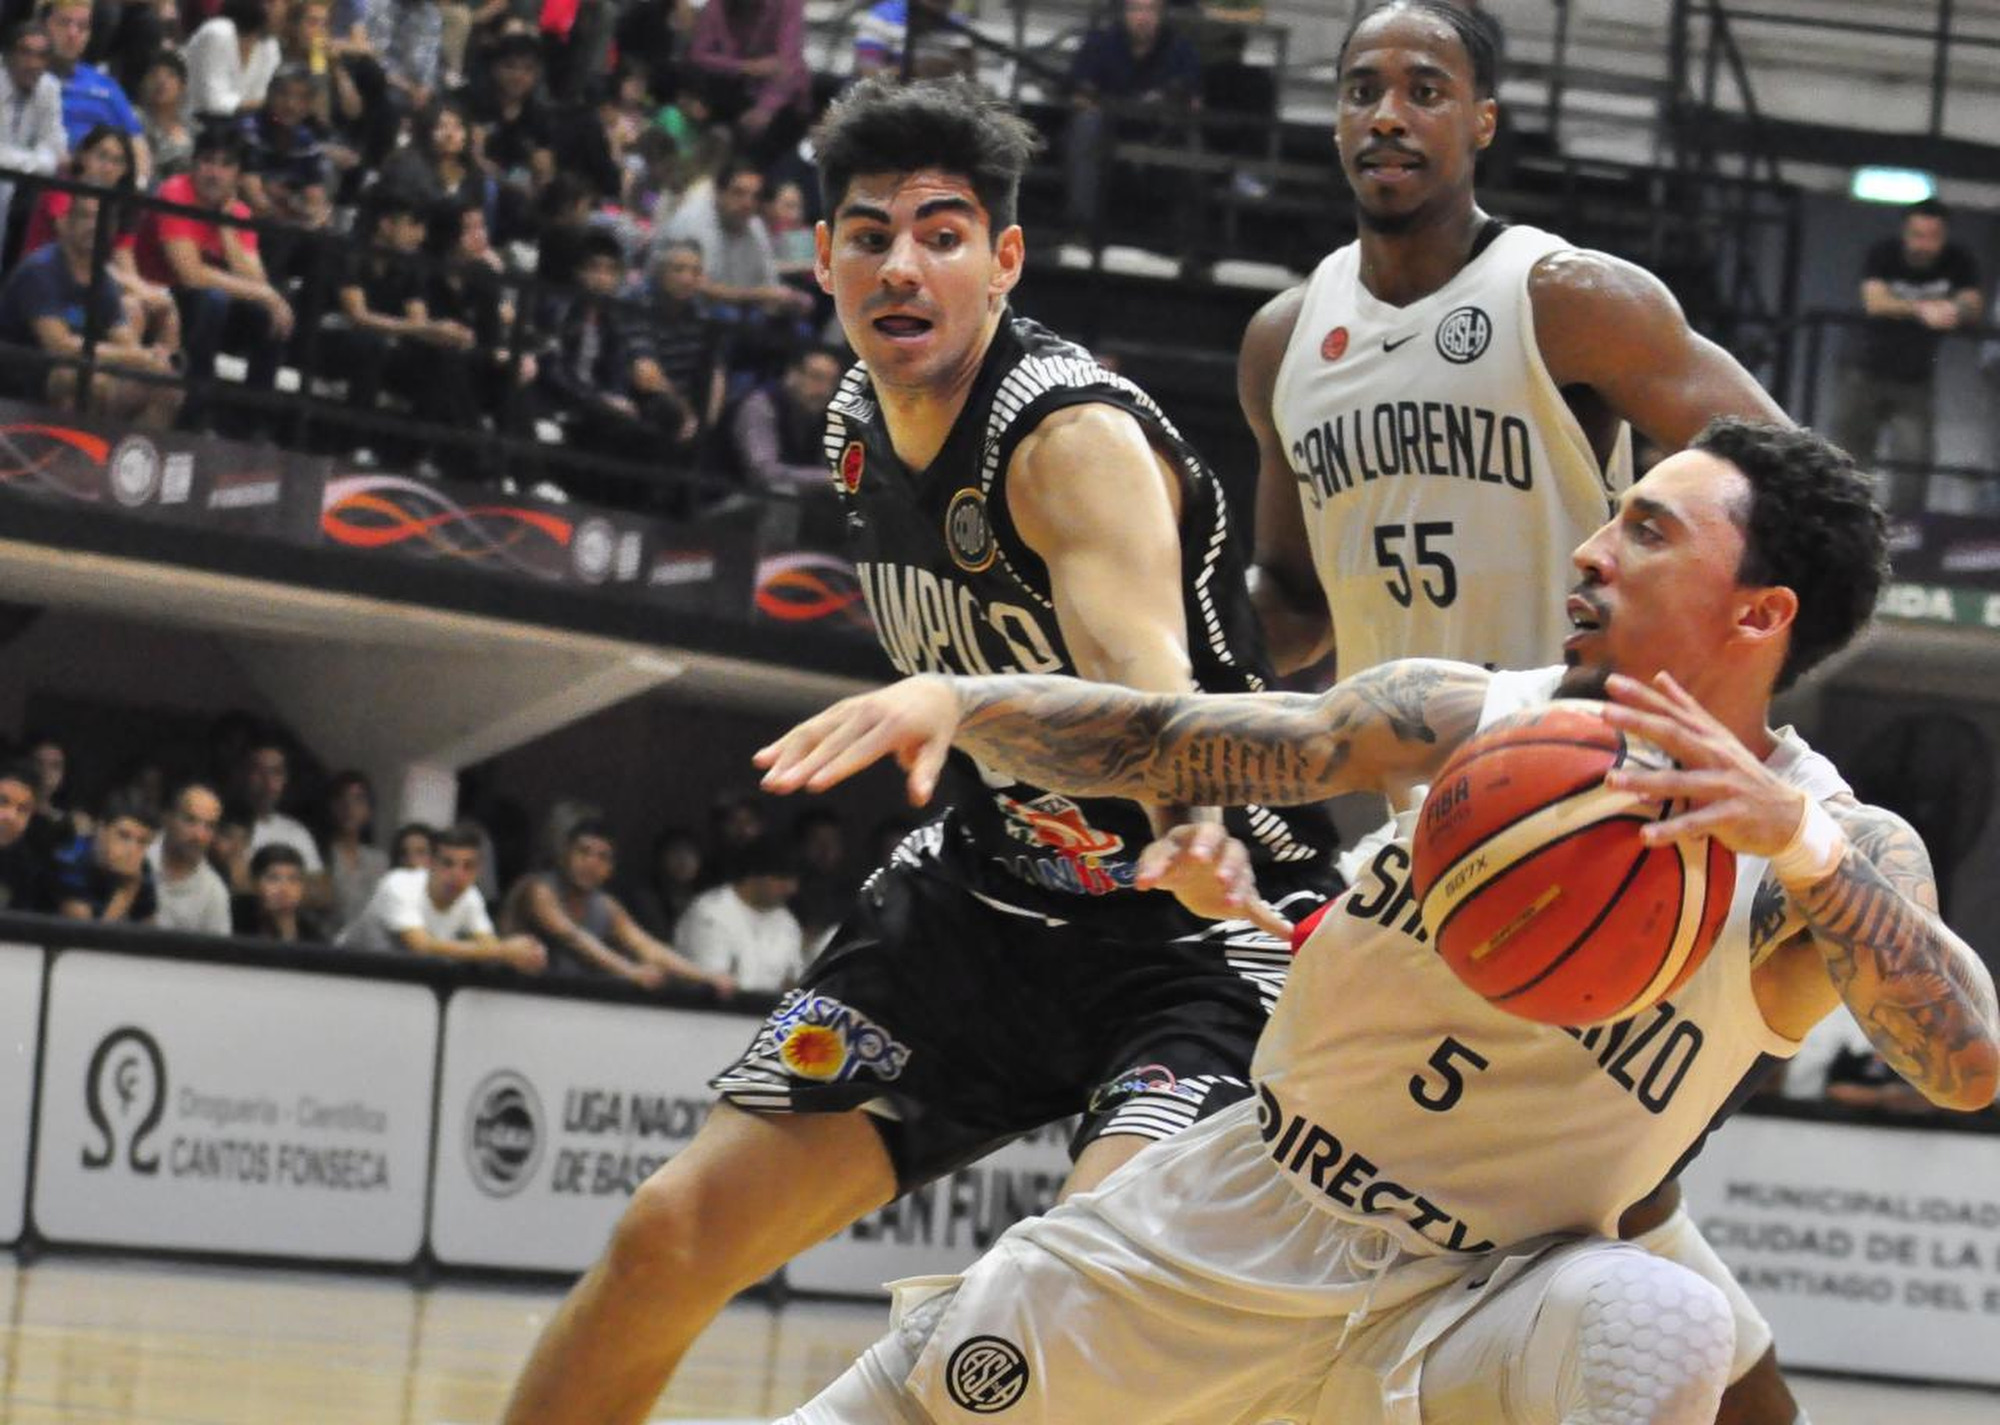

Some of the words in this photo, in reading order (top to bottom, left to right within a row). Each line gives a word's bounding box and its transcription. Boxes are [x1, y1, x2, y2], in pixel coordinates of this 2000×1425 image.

[1293, 416, 1354, 510] SAN
[1354, 401, 1533, 492] LORENZO
[1374, 521, 1457, 608] 55
[1408, 1036, 1489, 1112] 5
[563, 1087, 623, 1136] LIGA
[552, 1148, 590, 1196] DE
[1865, 1233, 1916, 1266] DE
[1931, 1240, 1981, 1271] LA
[1732, 1265, 1894, 1304] ANTIAGO
[1904, 1277, 1970, 1311] DEL
